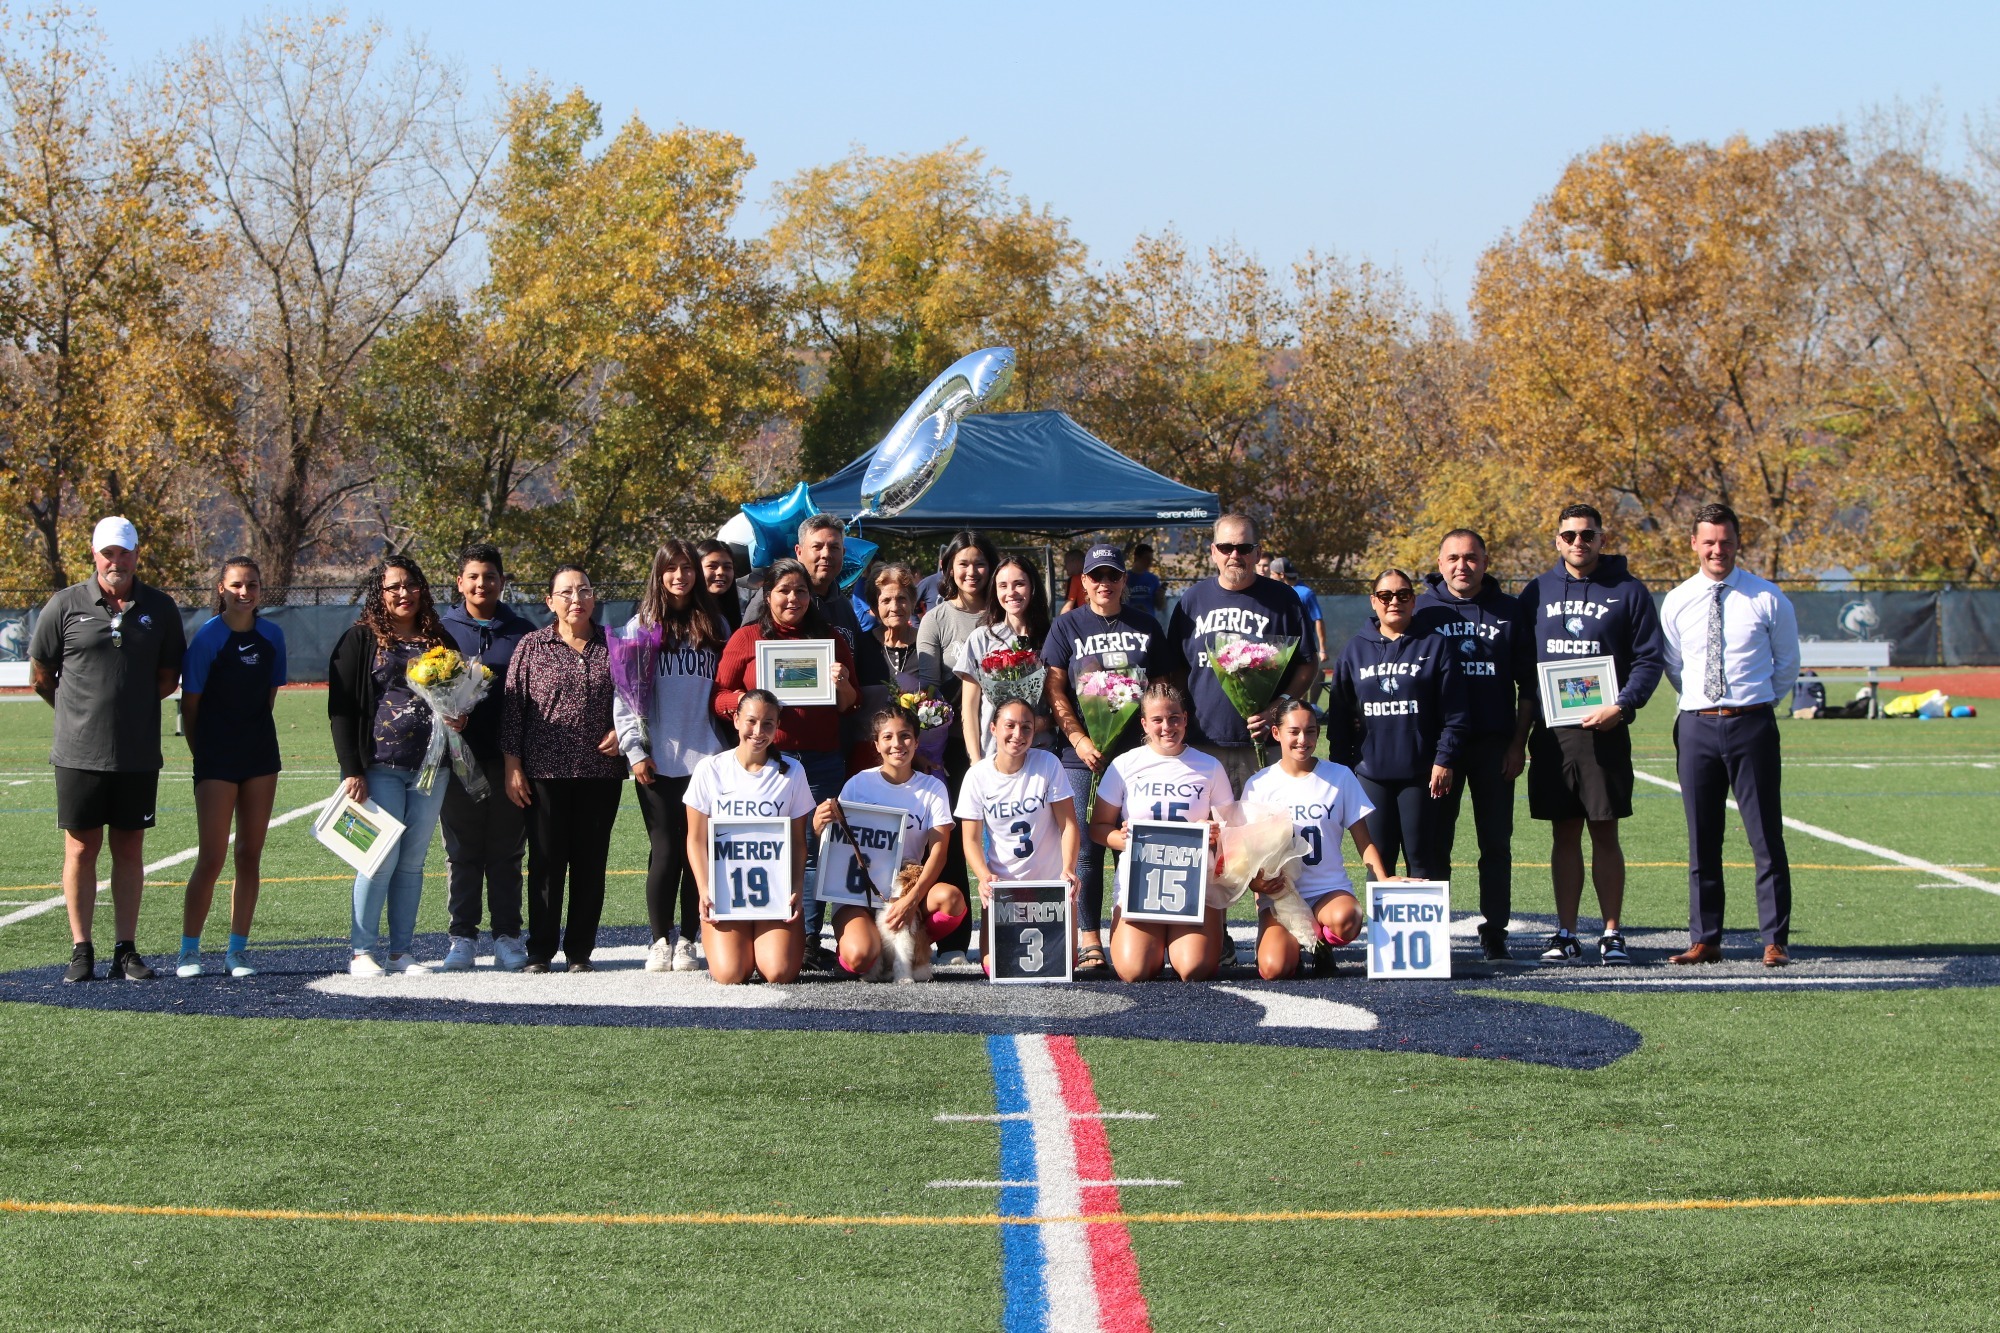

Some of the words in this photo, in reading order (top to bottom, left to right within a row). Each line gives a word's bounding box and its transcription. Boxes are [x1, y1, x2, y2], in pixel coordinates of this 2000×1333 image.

[1156, 508, 1208, 519] serenelife
[1546, 600, 1609, 620] MERCY
[1195, 607, 1269, 639] MERCY
[1435, 622, 1500, 640] MERCY
[1074, 631, 1149, 660] MERCY
[1546, 639, 1601, 655] SOCCER
[1107, 654, 1123, 667] 15
[1360, 662, 1421, 680] MERCY
[1461, 661, 1496, 676] CER
[1363, 700, 1418, 716] SOCCER
[1134, 783, 1204, 800] MERCY
[717, 800, 784, 817] MERCY
[983, 790, 1046, 819] MERCY
[1289, 804, 1335, 820] RCY
[830, 822, 900, 851] MERCY
[1010, 821, 1034, 858] 3
[1292, 826, 1323, 866] 0
[714, 841, 784, 861] MERCY
[1131, 842, 1202, 868] MERCY
[846, 852, 871, 894] 6
[730, 866, 770, 908] 19
[1143, 868, 1188, 912] 15
[995, 901, 1065, 923] MERCY
[1373, 904, 1443, 923] MERCY
[1019, 928, 1044, 972] 3
[1391, 930, 1431, 970] 10
